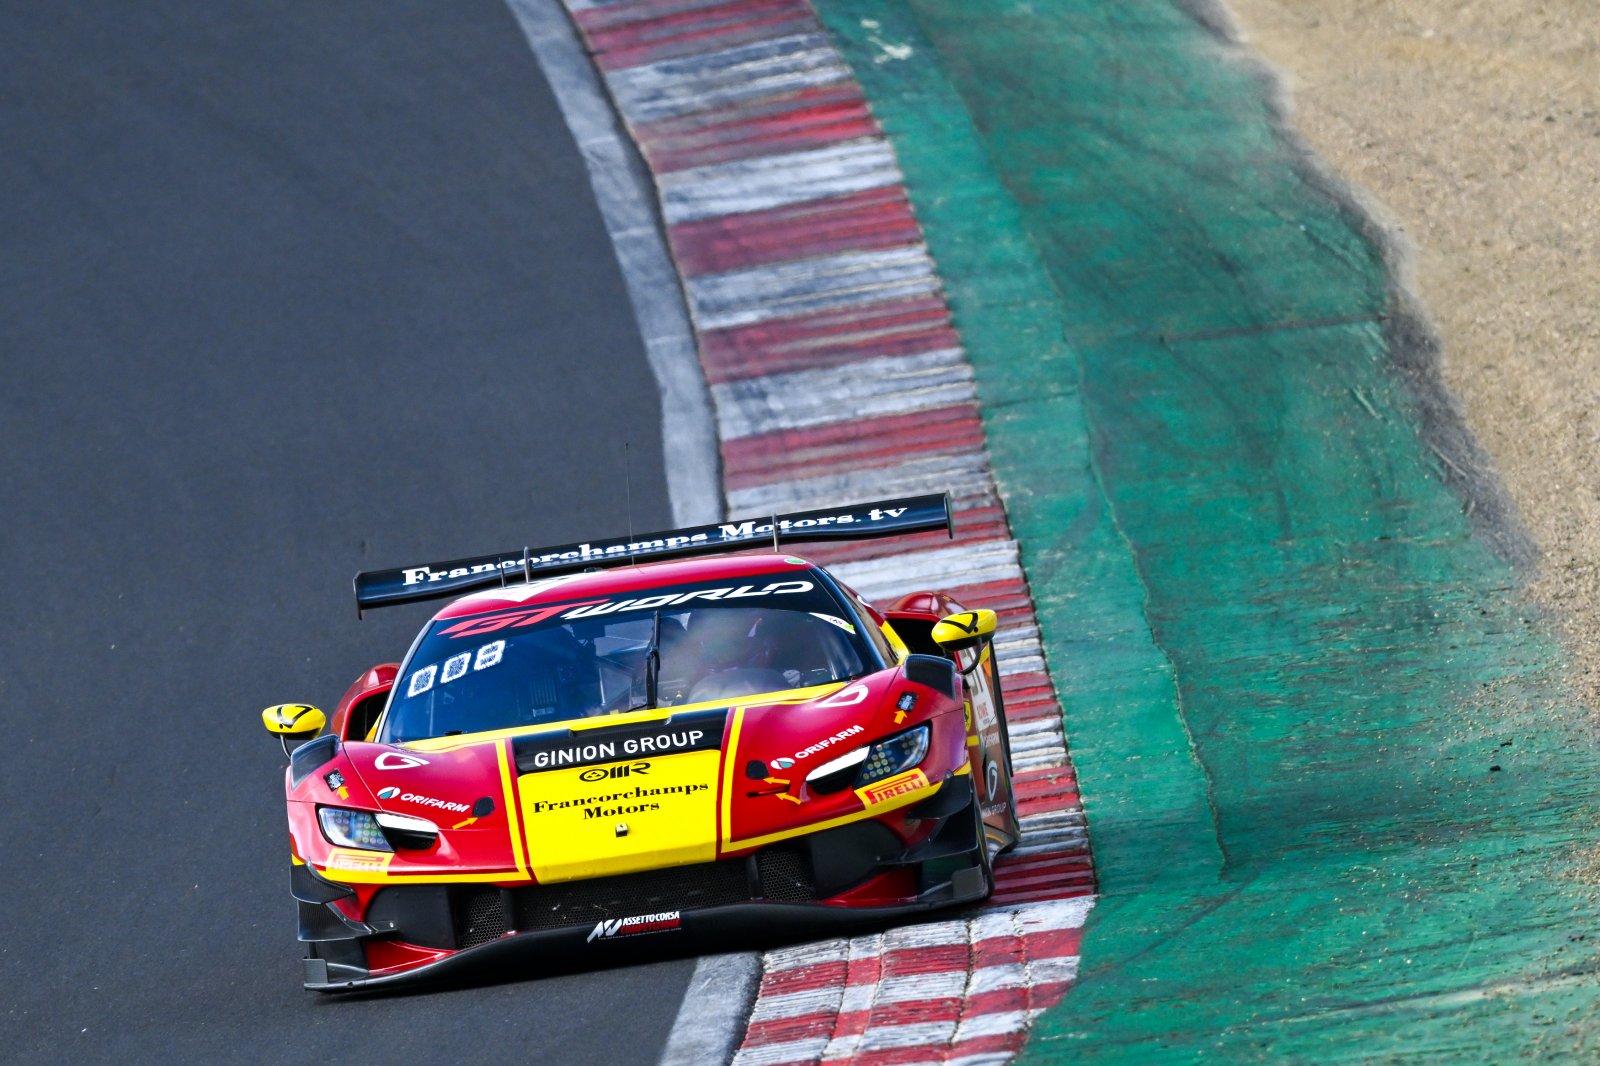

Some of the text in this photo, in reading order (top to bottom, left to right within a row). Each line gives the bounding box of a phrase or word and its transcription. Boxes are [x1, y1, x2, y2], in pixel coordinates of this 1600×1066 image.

[401, 532, 708, 586] Francorchamps
[560, 580, 814, 620] WORLD
[534, 730, 704, 767] GINION GROUP
[795, 724, 864, 759] ORIFARM
[401, 793, 470, 813] ORIFARM
[533, 782, 709, 814] Francorchamps
[864, 773, 925, 805] PIRELLI
[583, 802, 660, 820] Motors
[622, 914, 655, 926] ASSETTO
[655, 911, 680, 922] CORSA
